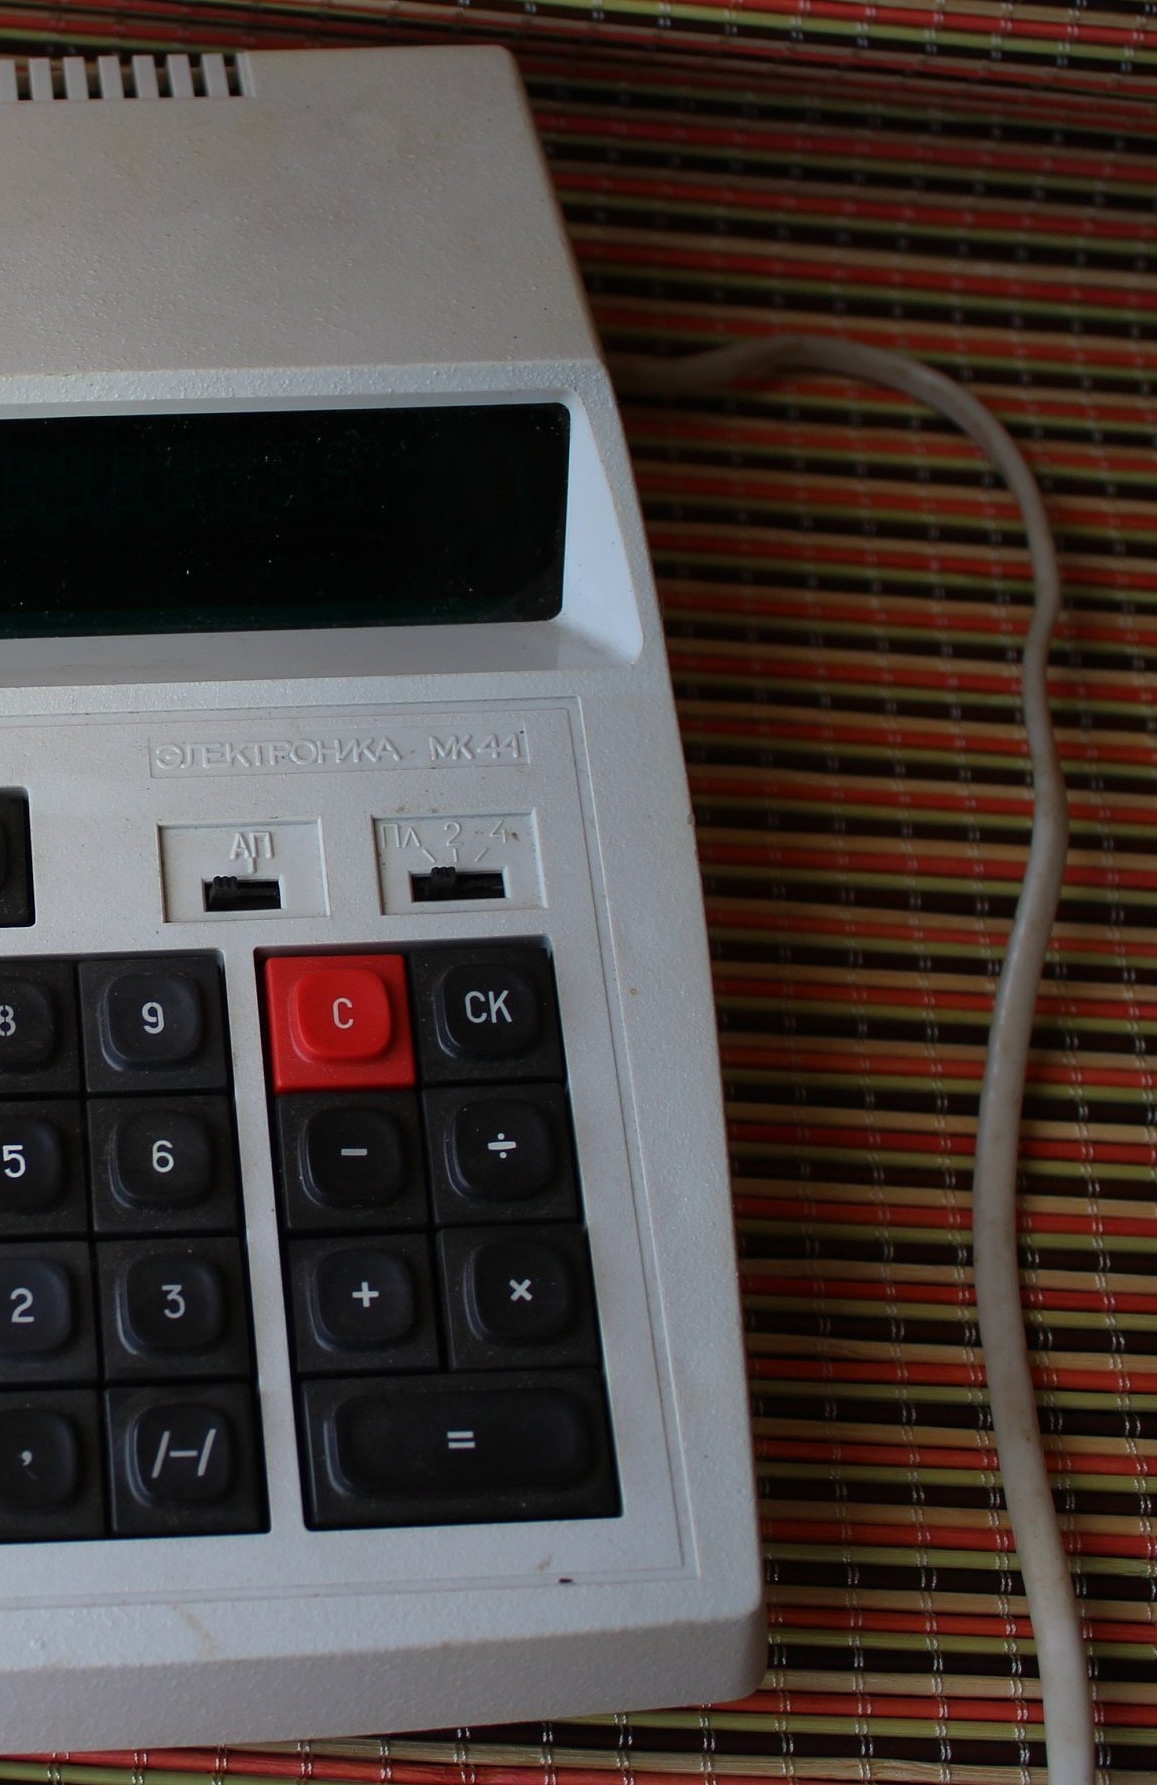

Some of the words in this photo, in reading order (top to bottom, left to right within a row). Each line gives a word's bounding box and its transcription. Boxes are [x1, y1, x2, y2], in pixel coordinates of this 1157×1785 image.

[155, 736, 403, 770] ЭЛЕКТРОНИКА
[230, 831, 273, 860] АП
[444, 822, 463, 846] 2
[489, 820, 506, 843] 4
[141, 1001, 165, 1034] 9
[2, 1144, 26, 1178] 5
[152, 1139, 175, 1173] 6
[10, 1287, 35, 1323] 2
[161, 1284, 185, 1319] 3
